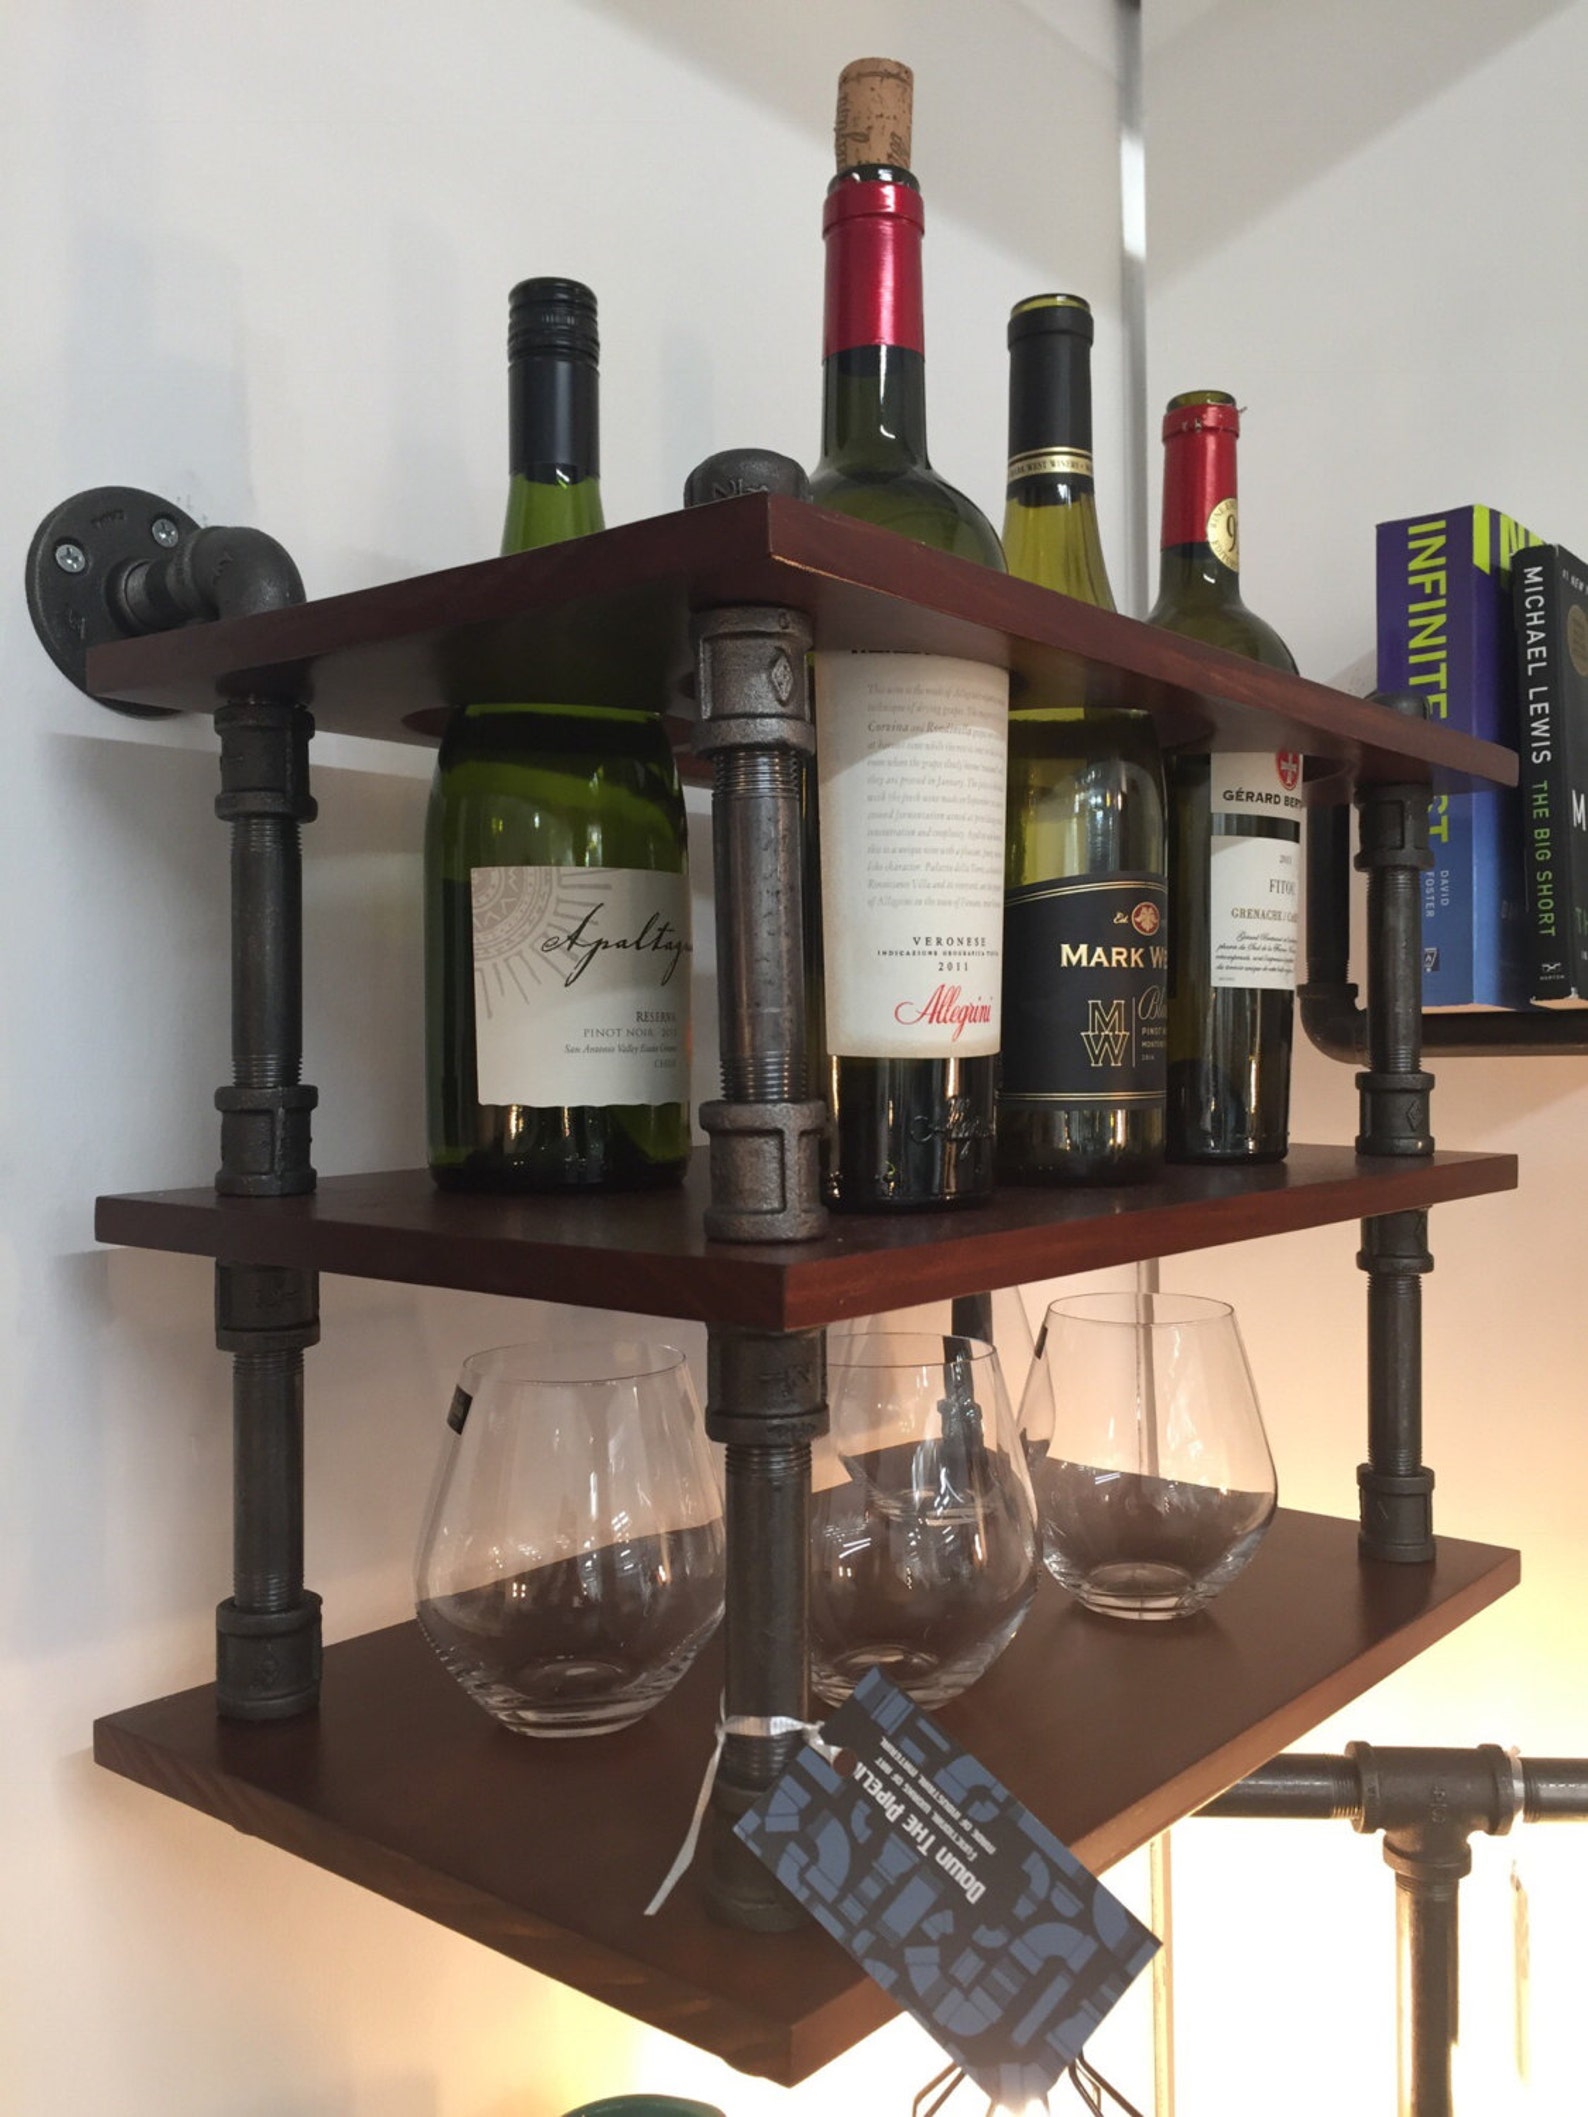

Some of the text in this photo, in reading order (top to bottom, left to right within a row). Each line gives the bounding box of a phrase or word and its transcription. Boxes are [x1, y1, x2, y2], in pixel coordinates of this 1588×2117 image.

[1571, 575, 1585, 592] NEW
[1523, 566, 1556, 937] MICHAEL LEWIS THE BIG SHORT
[1222, 787, 1281, 806] GÉRARD
[1425, 871, 1435, 918] FOSTER
[1440, 870, 1450, 907] DAVID
[913, 936, 986, 947] VERONESE
[1060, 943, 1145, 968] MARK
[938, 961, 968, 972] 2011
[894, 983, 993, 1042] Allegrini
[584, 1028, 622, 1039] PINOT
[626, 1028, 653, 1038] NOIR
[564, 1044, 582, 1054] San
[874, 1757, 893, 1775] ART
[891, 1772, 904, 1787] OF
[917, 1774, 962, 1820] INDUSTRIAL
[901, 1813, 936, 1857] THE
[959, 1819, 973, 1832] OF
[971, 1829, 997, 1856] MADE
